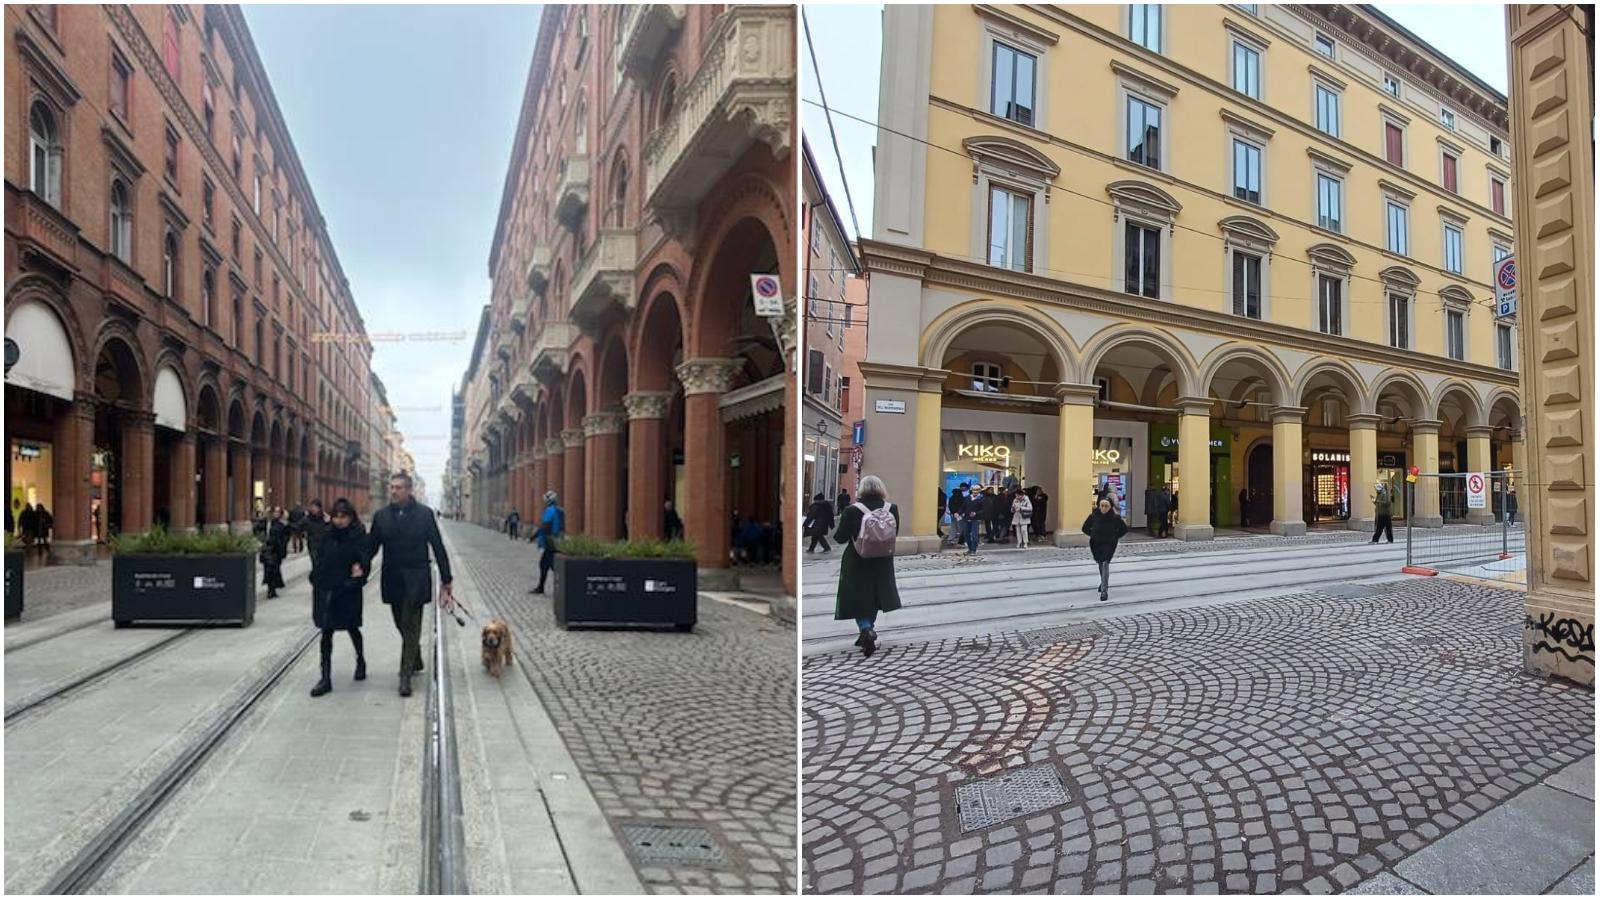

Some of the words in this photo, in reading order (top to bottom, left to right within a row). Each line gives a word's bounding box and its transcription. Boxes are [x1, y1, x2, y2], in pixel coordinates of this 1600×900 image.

[959, 444, 1010, 457] KIKO
[1091, 449, 1120, 461] IKO
[1312, 453, 1351, 462] SOLARIS
